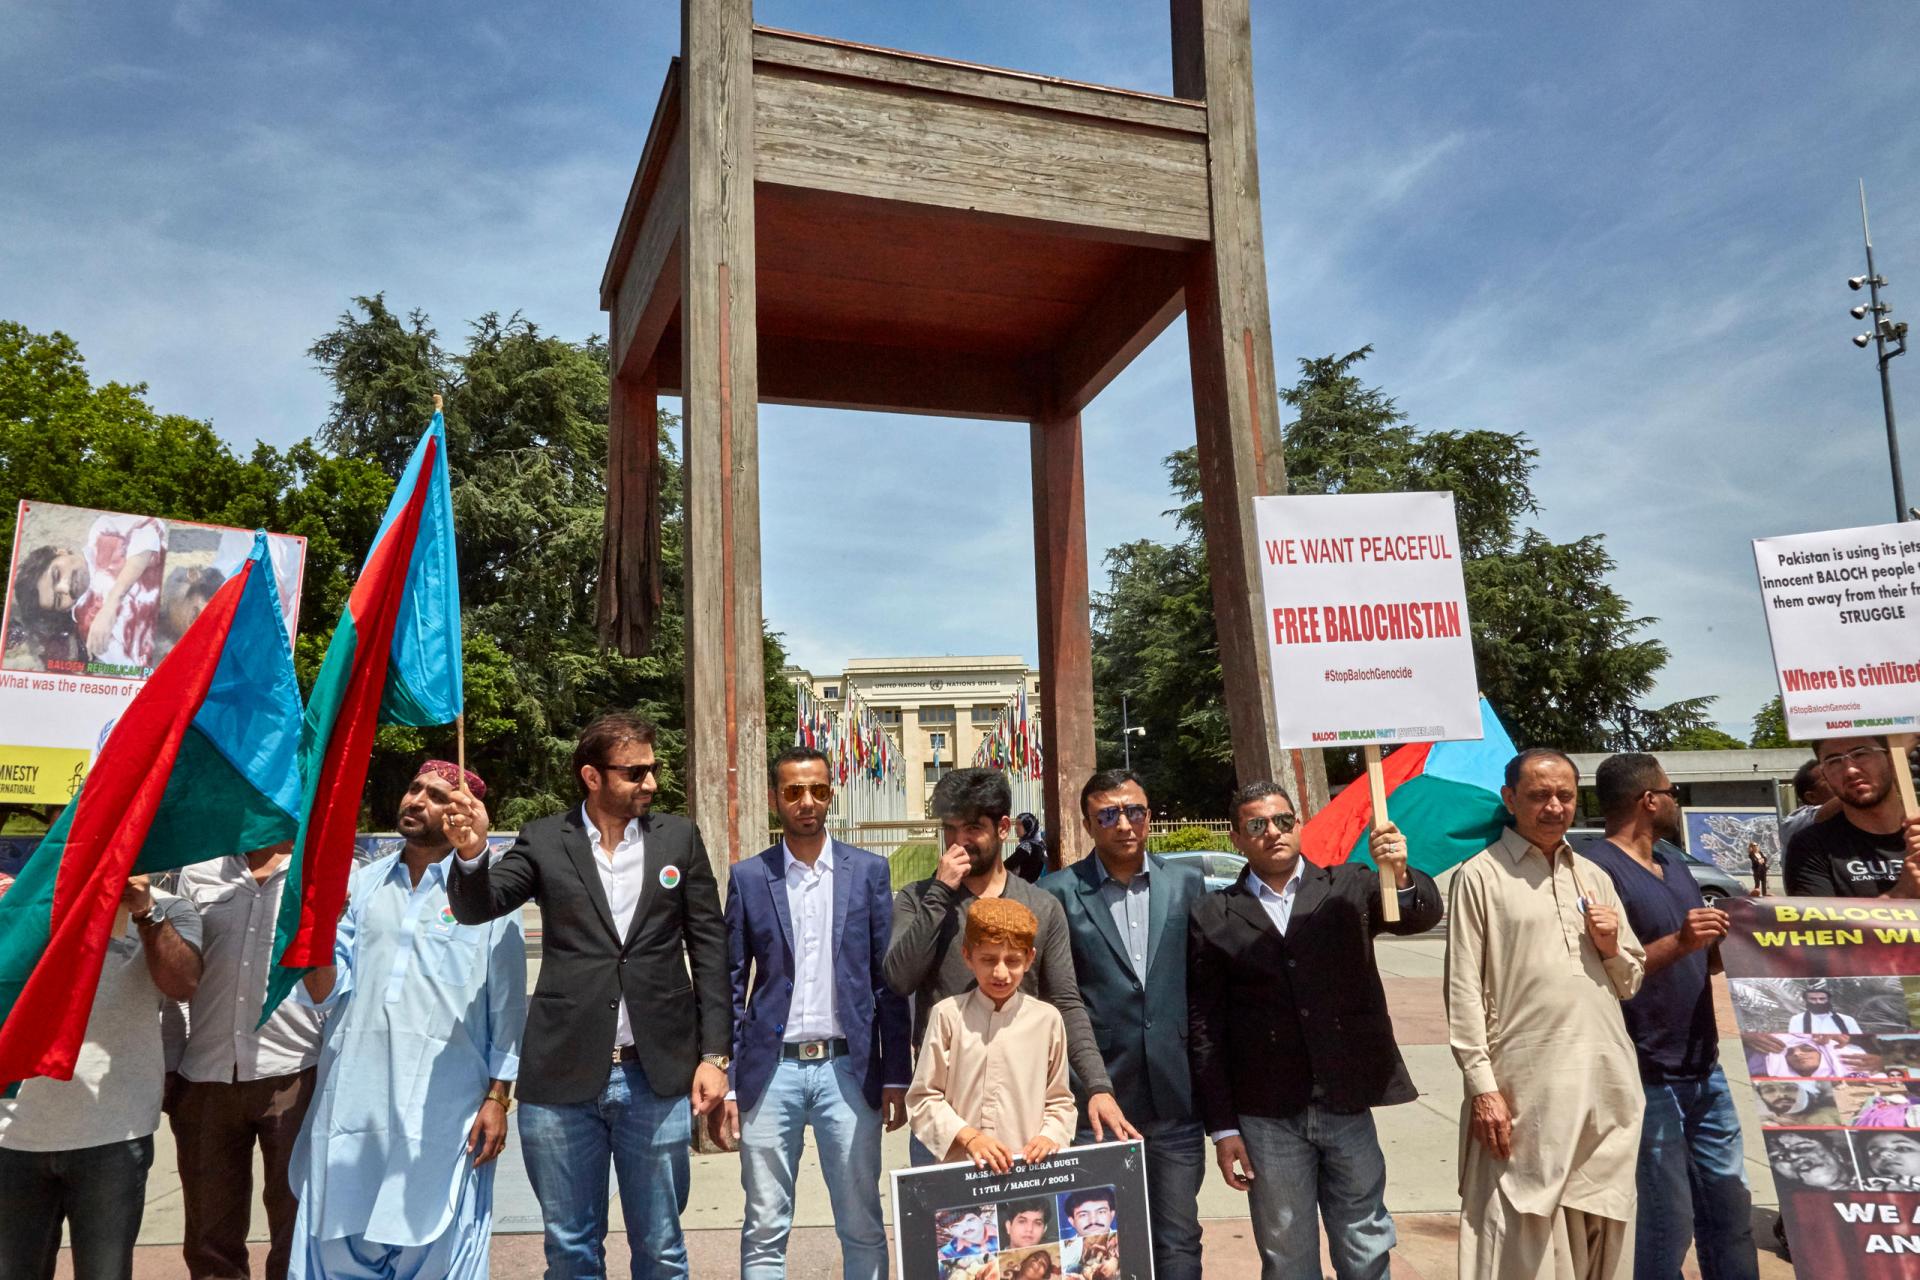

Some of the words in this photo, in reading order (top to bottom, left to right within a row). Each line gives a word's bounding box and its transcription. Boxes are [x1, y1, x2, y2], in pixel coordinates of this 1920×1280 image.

[1266, 540, 1297, 565] WE
[1301, 537, 1354, 564] WANT
[1360, 534, 1452, 562] PEACEFUL
[1778, 549, 1830, 567] Pakistan
[1833, 547, 1843, 560] is
[1846, 544, 1880, 561] using
[1881, 542, 1897, 556] its
[1762, 575, 1814, 589] innocent
[1817, 566, 1868, 585] BALOCH
[1872, 561, 1914, 582] people
[1773, 595, 1804, 609] them
[1807, 591, 1842, 608] away
[1845, 587, 1876, 603] from
[1878, 583, 1908, 599] their
[1273, 606, 1321, 645] FREE
[1323, 601, 1462, 643] BALOCHISTAN
[1839, 605, 1905, 624] STRUGGLE
[47, 659, 85, 671] BALOCH
[87, 663, 140, 676] REPUBLICAN
[1324, 667, 1413, 683] #StopBalochGenocide
[0, 674, 28, 689] What
[32, 680, 55, 691] was
[58, 679, 77, 692] the
[80, 682, 118, 696] reason
[121, 684, 133, 696] of
[1782, 667, 1838, 692] Where
[1839, 665, 1856, 688] is
[1790, 702, 1861, 715] #StopBalochGenocide
[1826, 720, 1853, 729] BALOCH
[1312, 731, 1338, 741] BALOCH
[1338, 729, 1376, 740] REPUBLICAN
[1376, 728, 1397, 738] PARTY
[1846, 859, 1904, 875] GUE
[1774, 905, 1919, 922] BALOCH
[1752, 929, 1864, 947] WHEN
[965, 1167, 1012, 1180] MASSAE
[1015, 1165, 1026, 1174] OF
[1054, 1157, 1079, 1168] BUGTI
[979, 1184, 1000, 1195] 17TH
[1010, 1178, 1040, 1190] MARCH
[1833, 1202, 1900, 1224] WE
